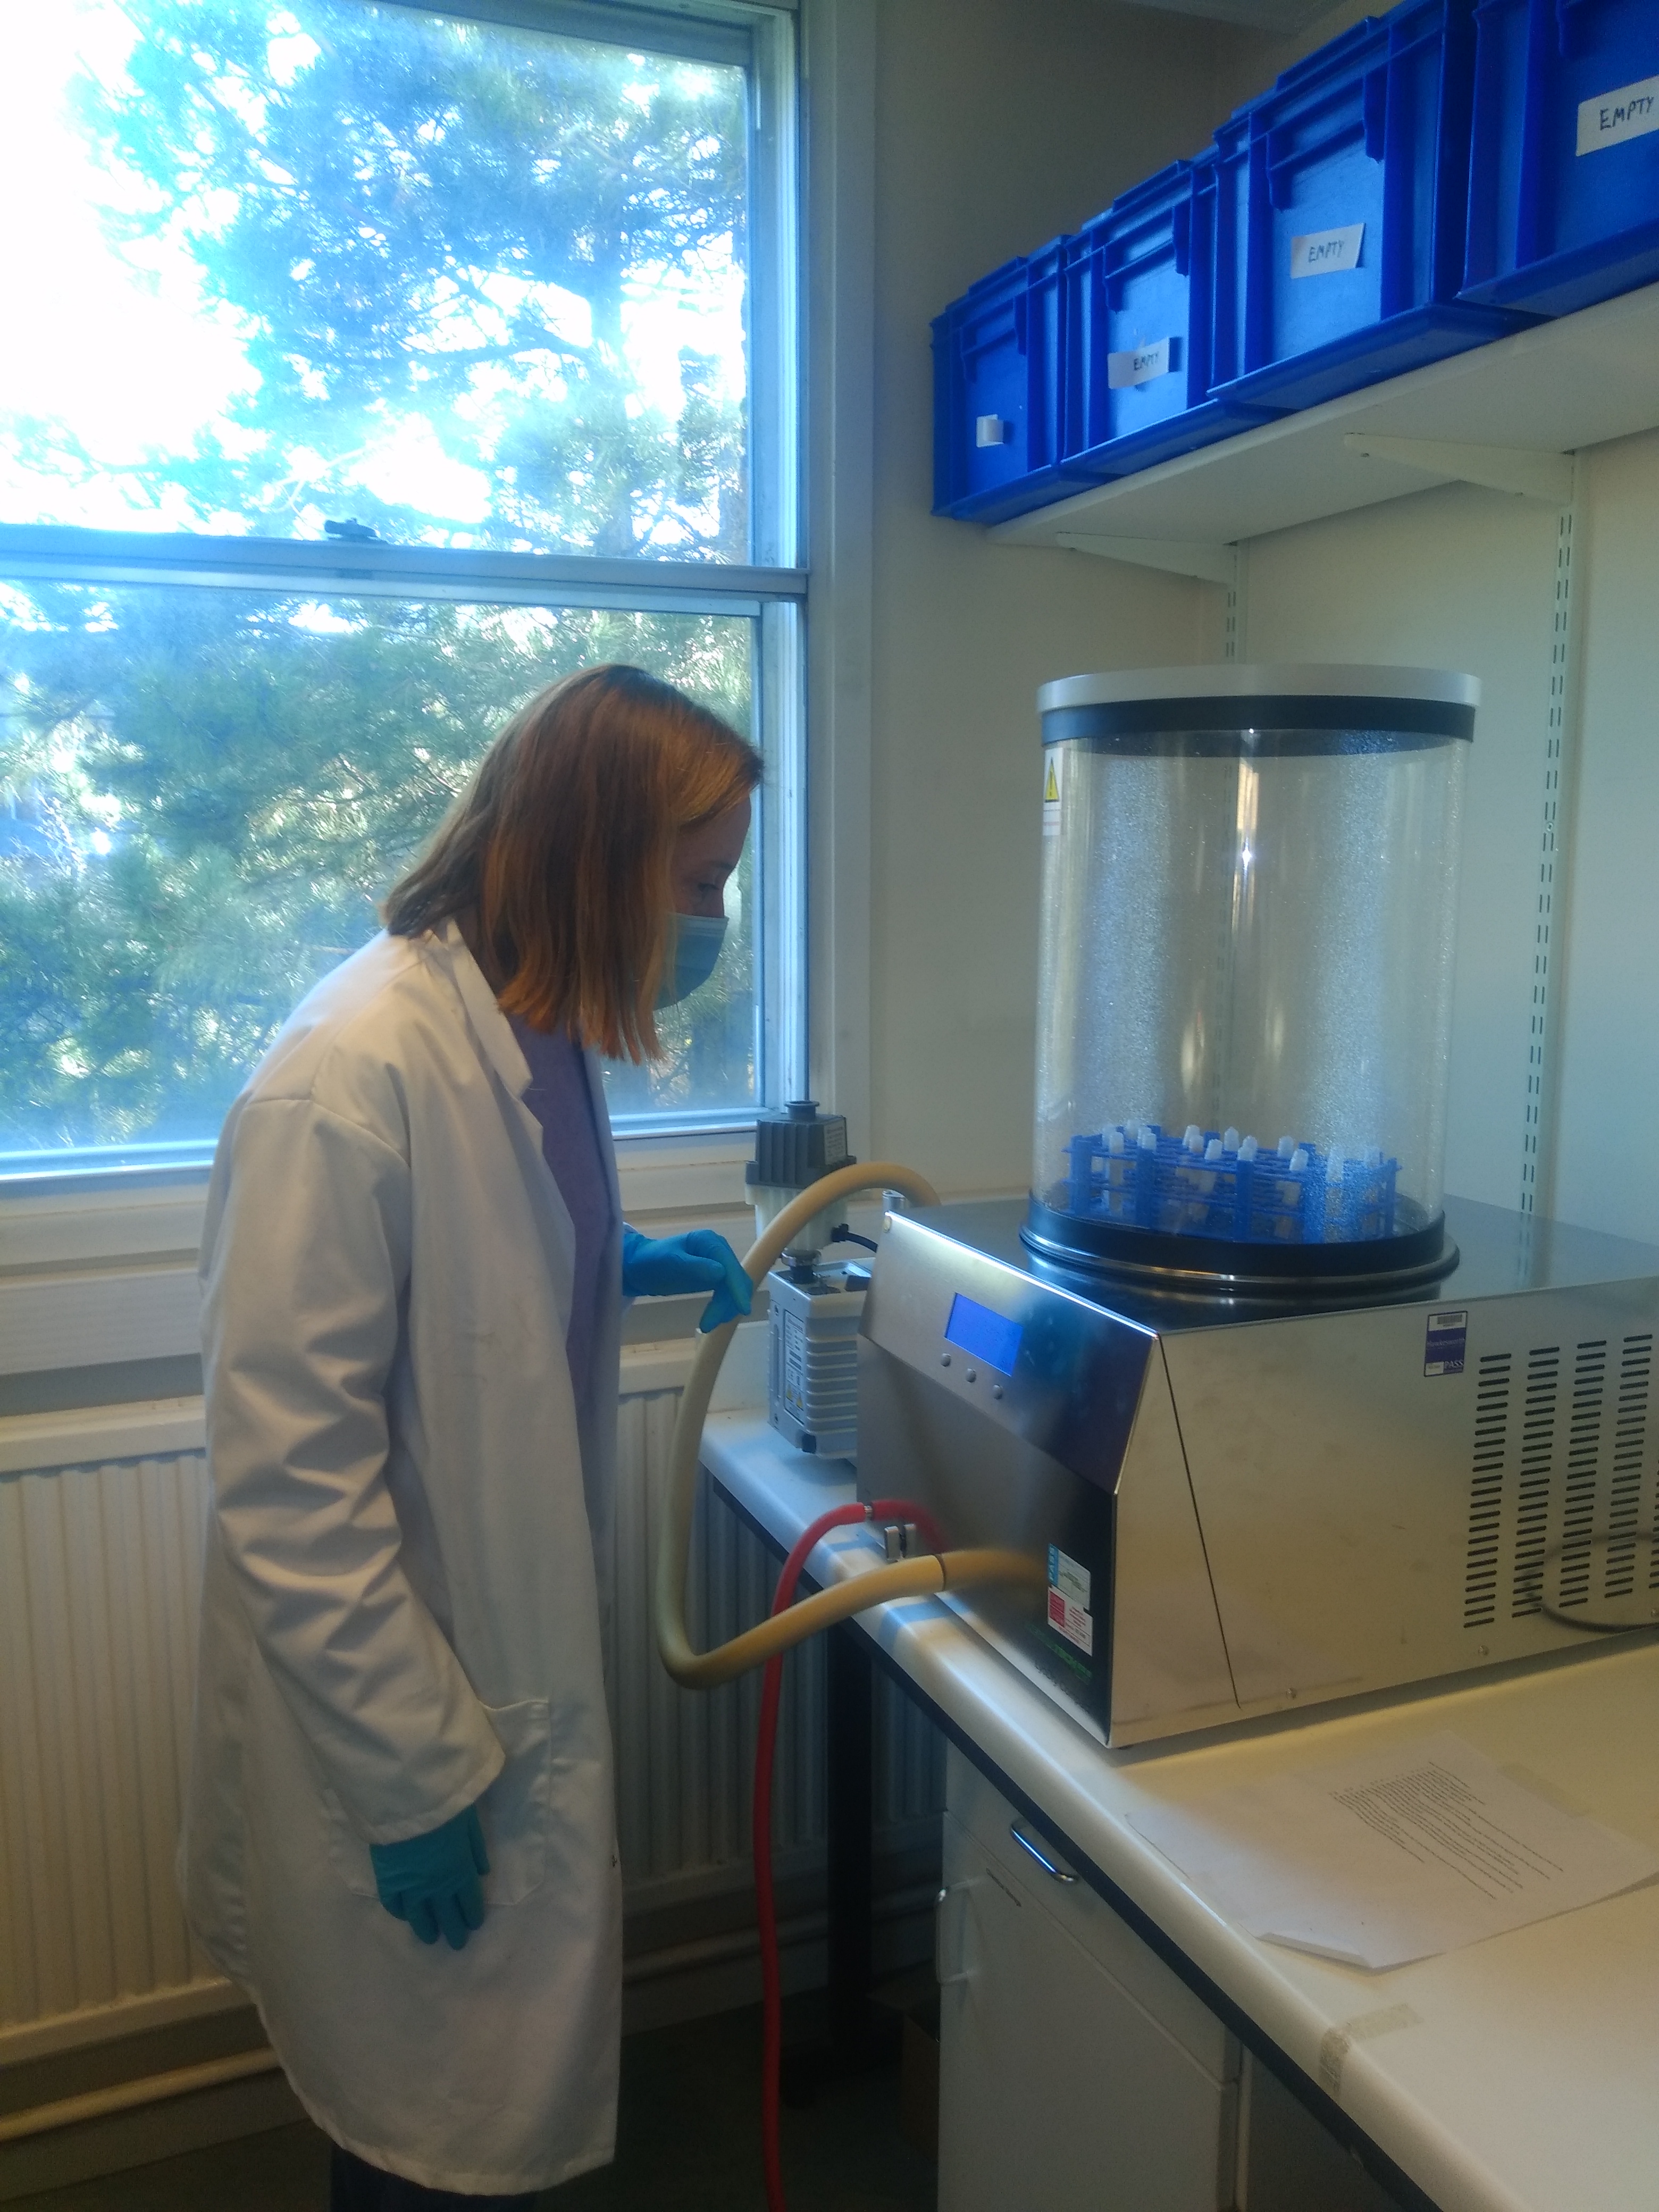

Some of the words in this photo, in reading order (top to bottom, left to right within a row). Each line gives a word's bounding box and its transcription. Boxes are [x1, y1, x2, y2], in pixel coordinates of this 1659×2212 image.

[1600, 96, 1654, 131] EMPTY
[1308, 240, 1344, 263] EMPTY
[1133, 351, 1159, 371] EMPTY
[1444, 1360, 1464, 1370] PASS
